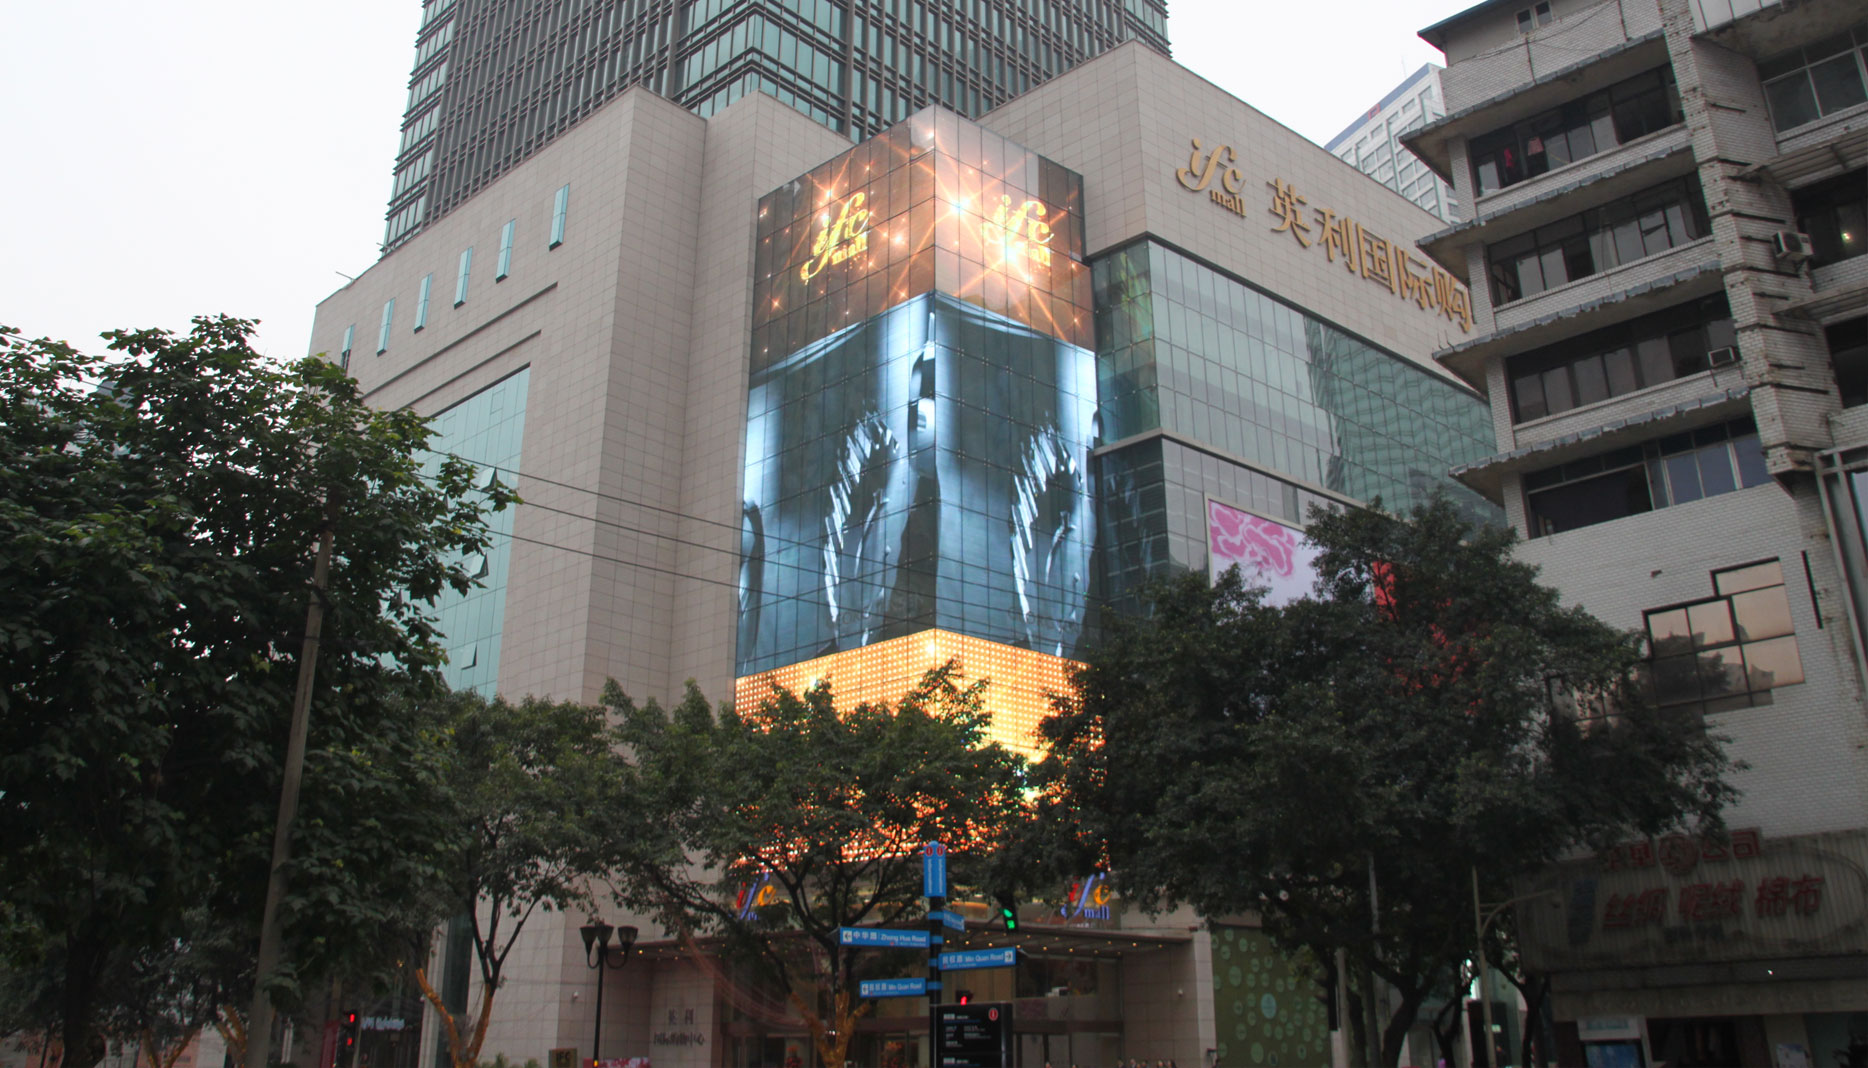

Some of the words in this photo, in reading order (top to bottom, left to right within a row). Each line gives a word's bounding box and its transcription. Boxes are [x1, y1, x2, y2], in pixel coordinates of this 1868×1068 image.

[1176, 137, 1247, 195] ifc
[1208, 189, 1247, 219] mall
[831, 231, 868, 266] mall
[1266, 177, 1471, 333] 英利国际购
[1755, 873, 1825, 917] 棉布
[1084, 904, 1110, 920] mall
[881, 933, 899, 943] Zhong
[990, 953, 1004, 961] Road
